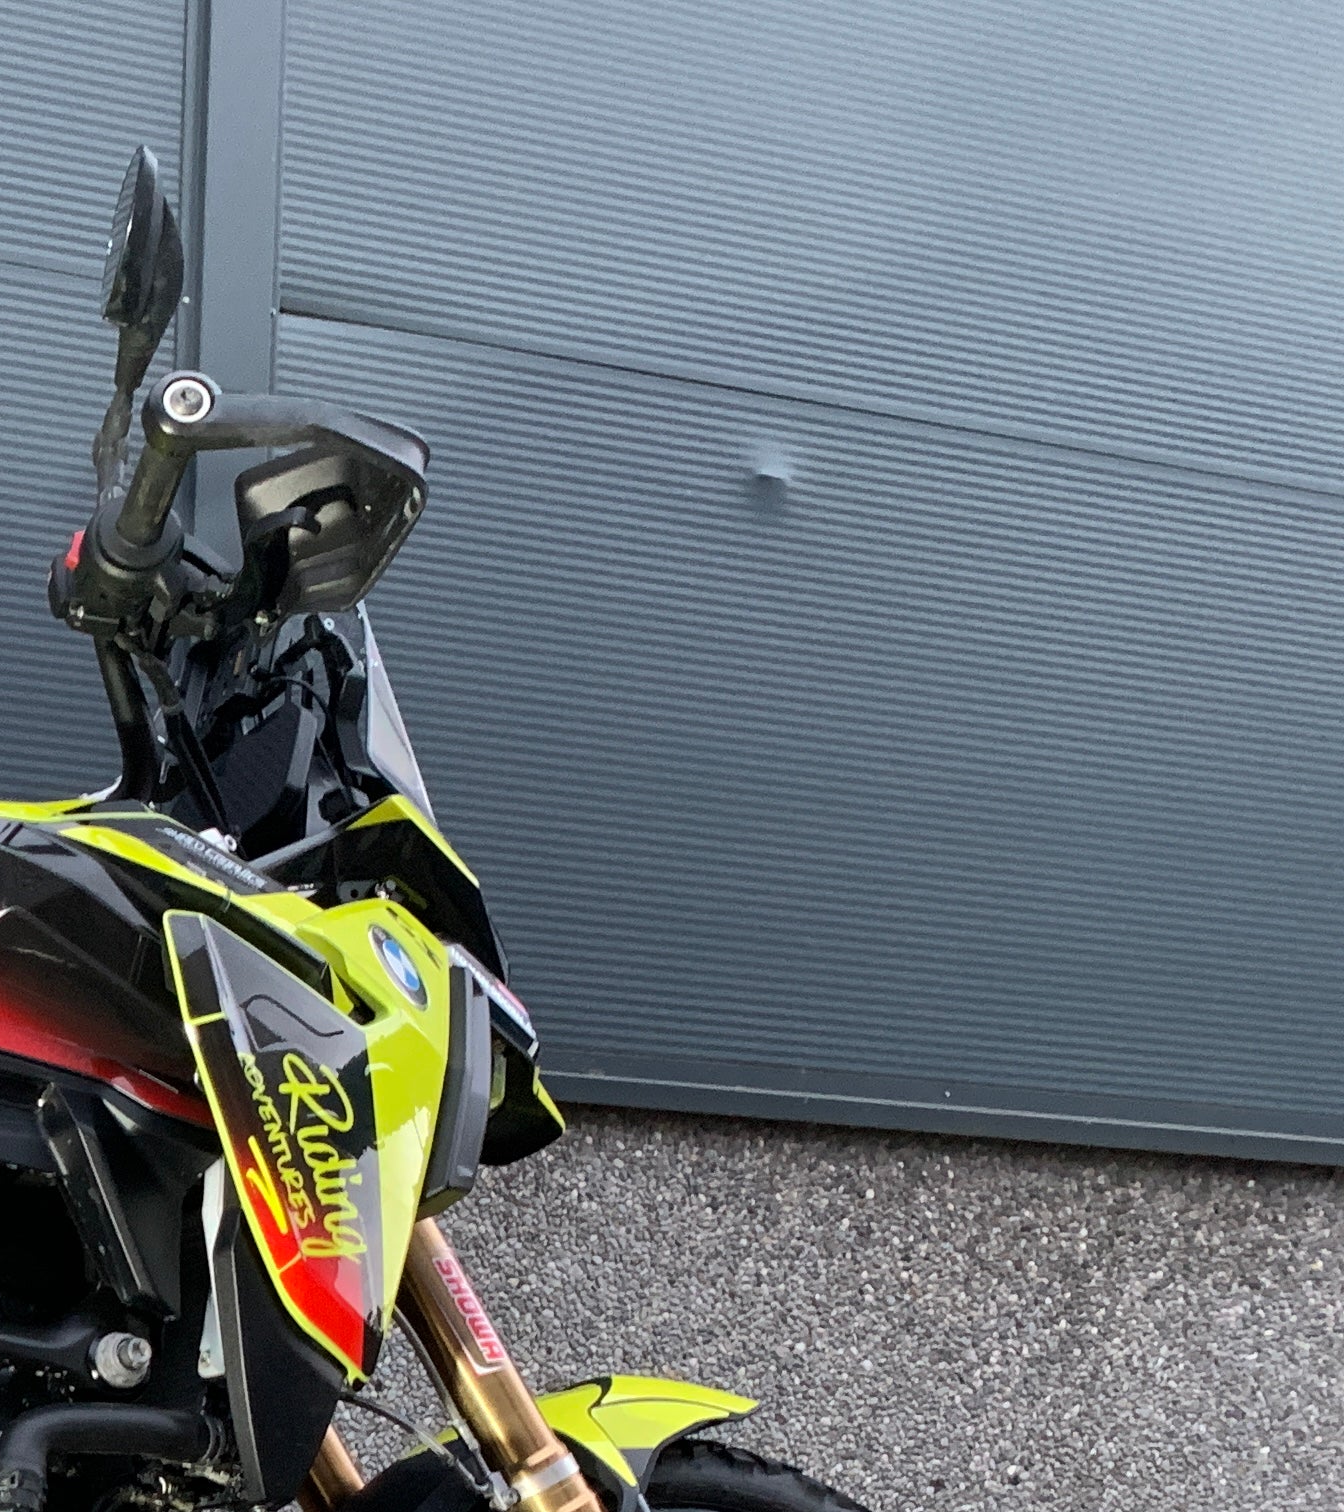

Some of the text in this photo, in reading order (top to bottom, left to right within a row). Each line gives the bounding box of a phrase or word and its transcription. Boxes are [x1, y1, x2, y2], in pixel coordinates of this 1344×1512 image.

[237, 1052, 316, 1230] ADVENTURES
[278, 1052, 368, 1264] Riding
[433, 1258, 507, 1364] SHOWA
